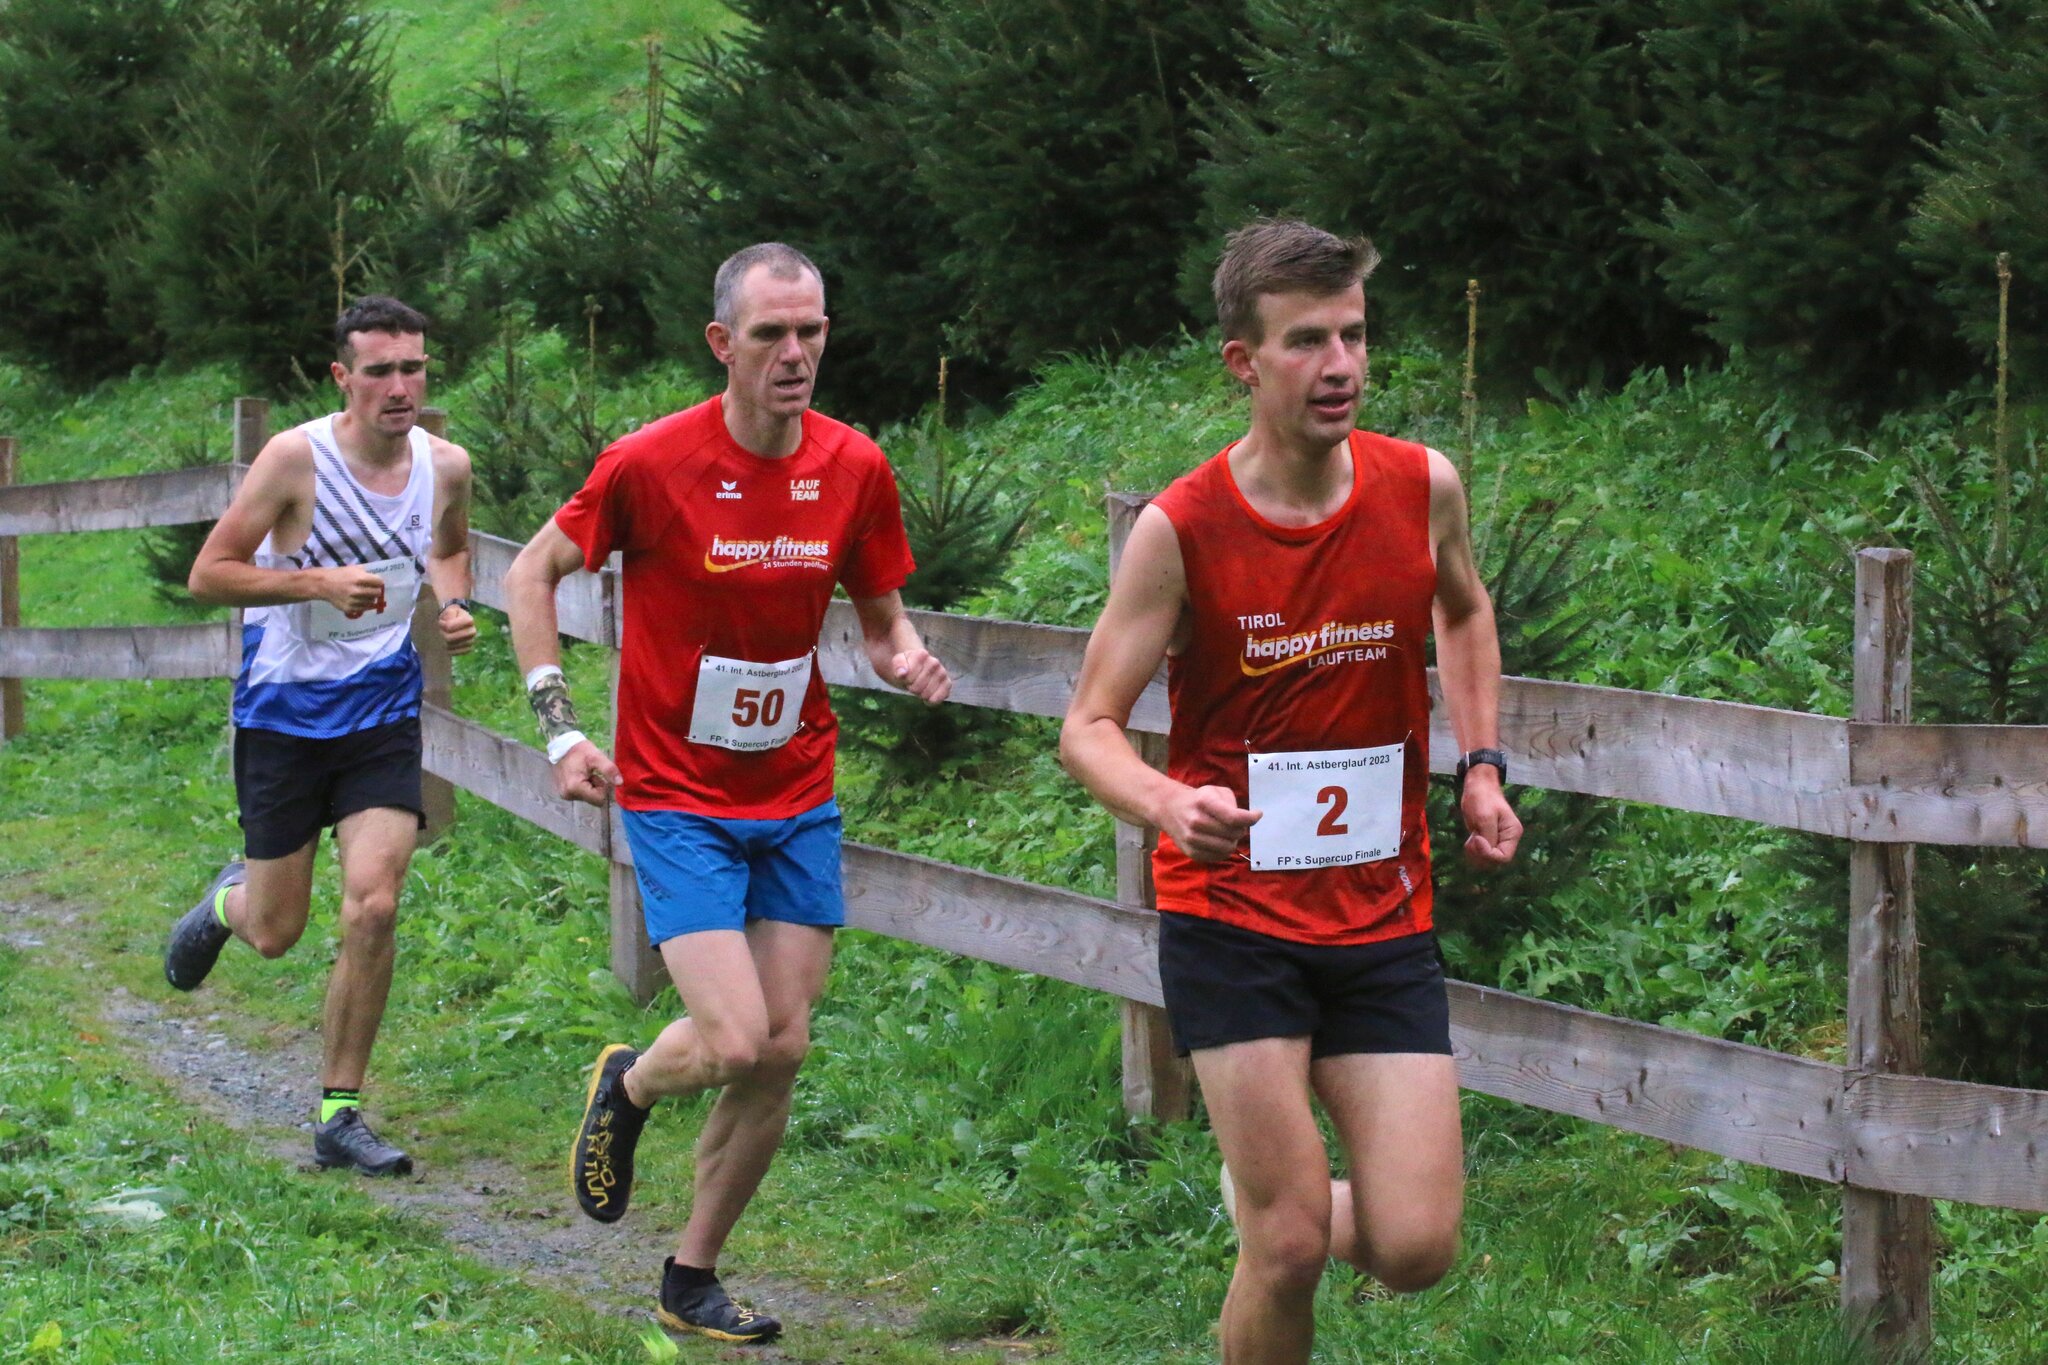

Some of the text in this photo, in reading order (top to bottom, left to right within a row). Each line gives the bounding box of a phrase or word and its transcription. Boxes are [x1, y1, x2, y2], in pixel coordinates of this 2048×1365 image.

[790, 480, 820, 490] LAUF
[716, 491, 742, 499] erima
[791, 491, 820, 501] TEAM
[712, 535, 829, 560] happy fitness
[773, 560, 803, 568] Stunden
[1237, 613, 1286, 630] TIROL
[1245, 620, 1395, 660] happy fitness
[1308, 647, 1387, 669] LAUFTEAM
[715, 664, 728, 673] 41.
[730, 666, 744, 675] Int.
[731, 687, 785, 728] 50
[731, 739, 769, 749] Supercup
[1268, 754, 1390, 771] 41. Int. Astberglauf 2023
[1316, 785, 1348, 836] 2
[1304, 851, 1353, 865] Supercup
[1355, 848, 1381, 860] Finale
